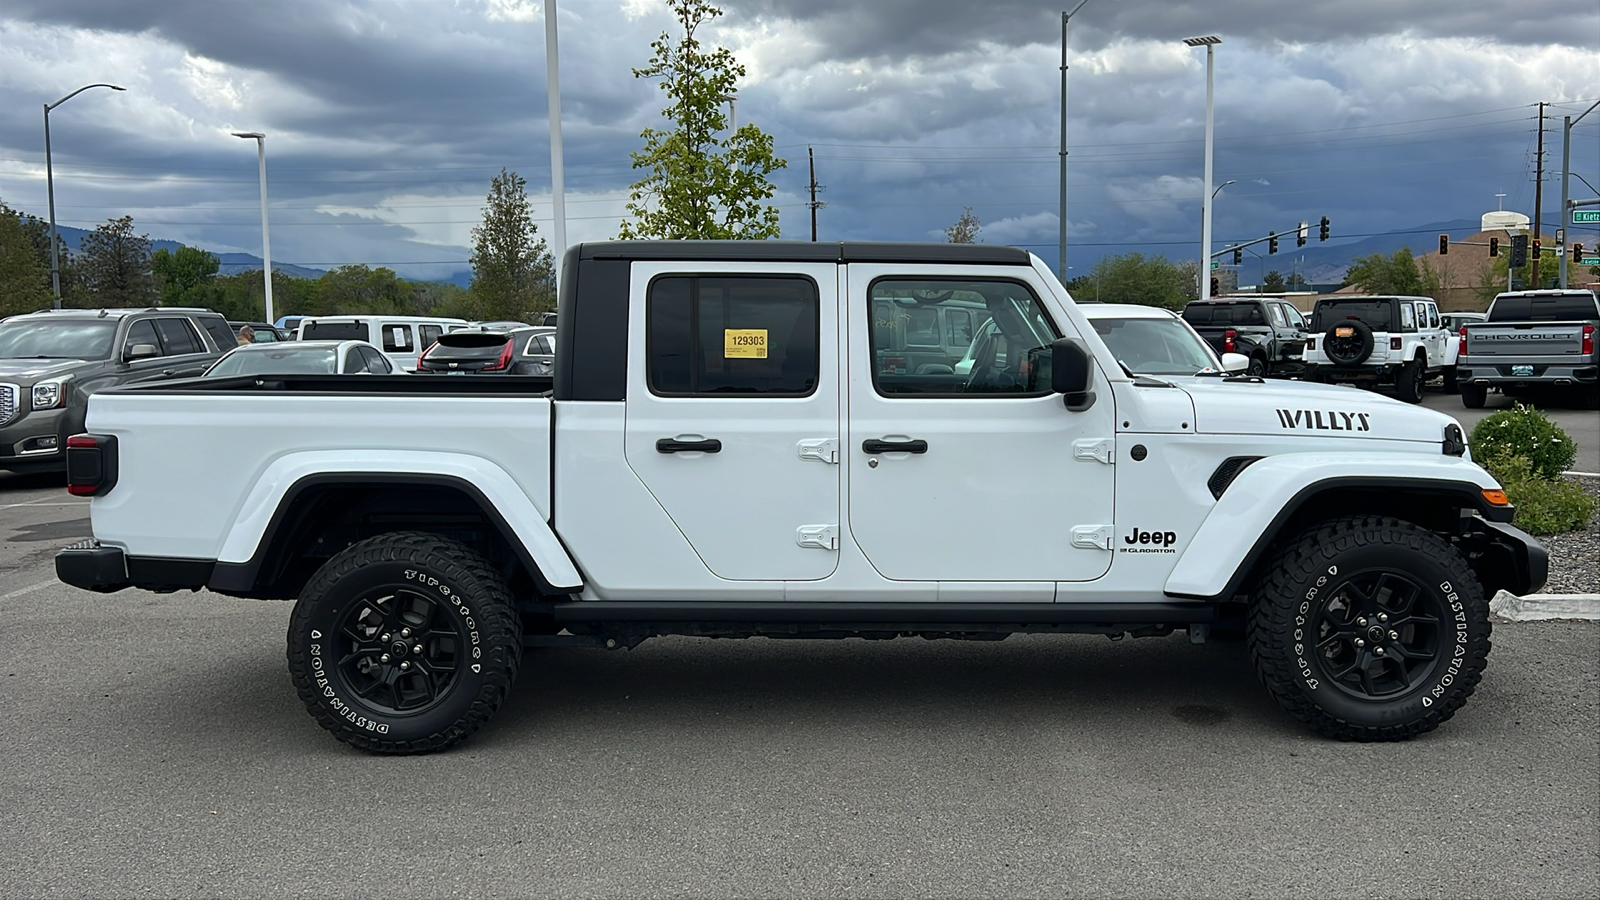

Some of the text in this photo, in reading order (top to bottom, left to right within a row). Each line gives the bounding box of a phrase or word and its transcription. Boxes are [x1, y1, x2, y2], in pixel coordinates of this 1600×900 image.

[732, 335, 765, 346] 129303
[1474, 333, 1574, 341] CHEVROLET
[1275, 408, 1370, 432] WILLYS
[1124, 527, 1177, 548] Jeep
[404, 569, 481, 660] Firestone
[1293, 576, 1328, 690] Firestone
[1431, 580, 1469, 698] DESTINATION
[310, 643, 389, 735] DESTINATION
